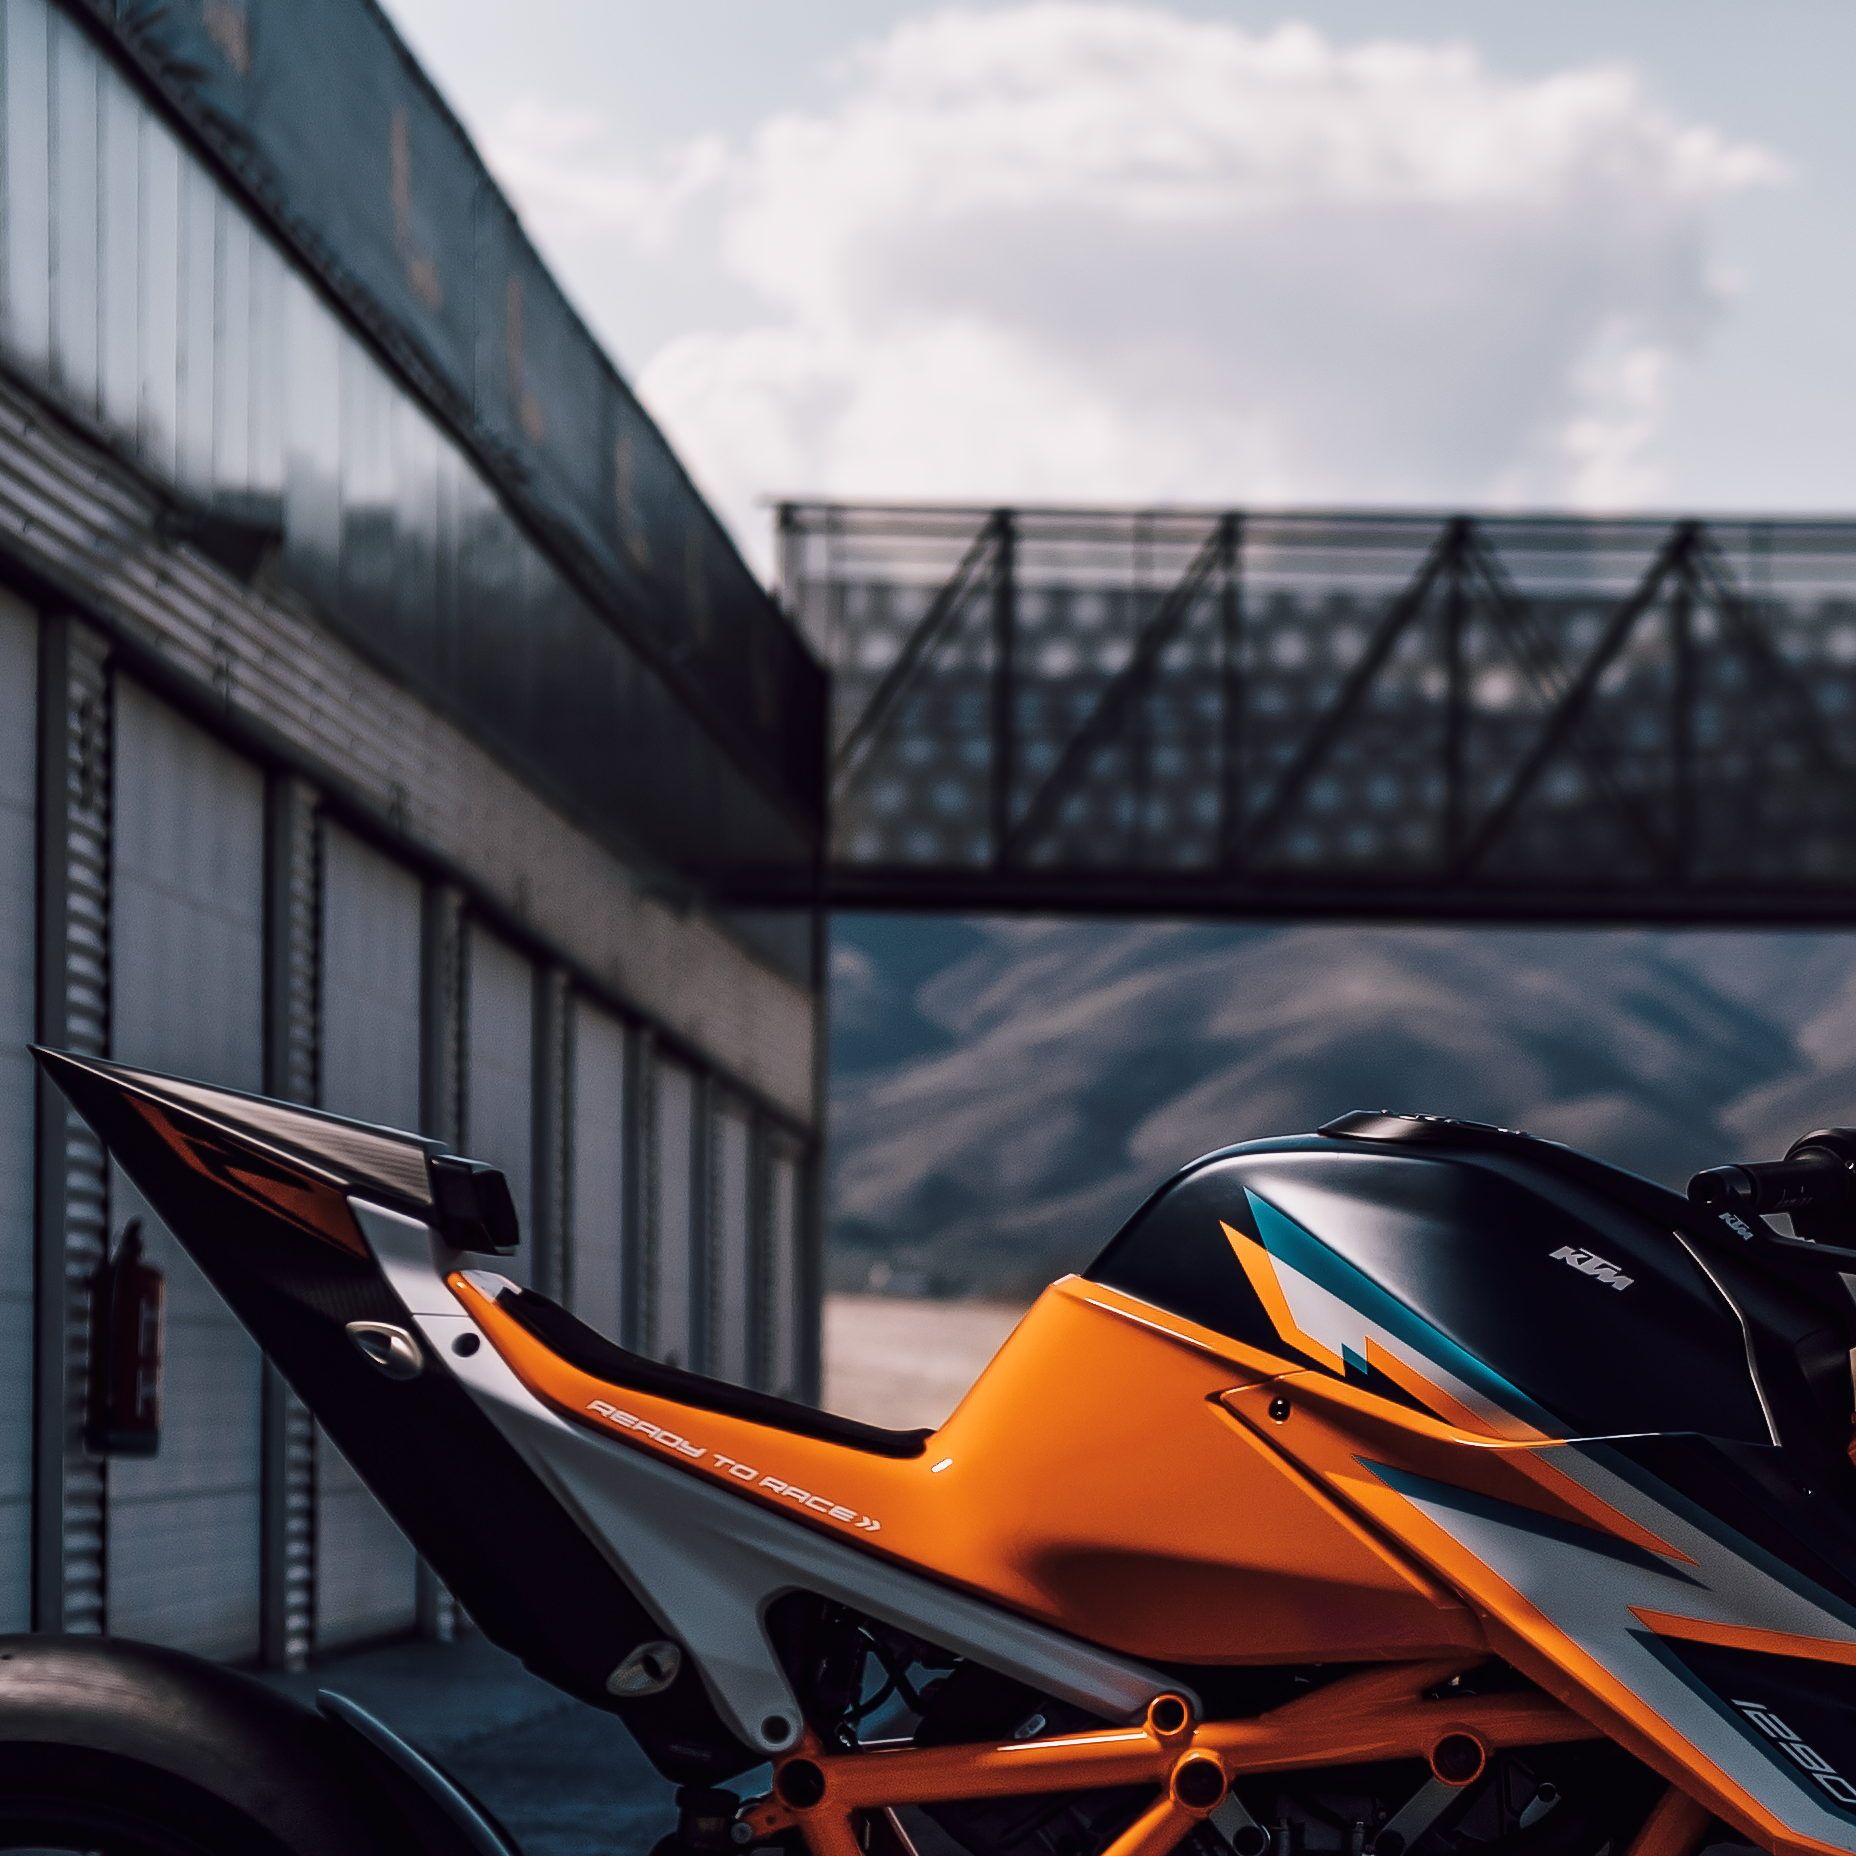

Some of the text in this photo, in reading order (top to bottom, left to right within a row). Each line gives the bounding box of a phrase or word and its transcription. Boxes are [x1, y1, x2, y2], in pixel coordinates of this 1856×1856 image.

[1718, 1212, 1755, 1242] KTM
[1548, 1245, 1635, 1291] KTM
[586, 1399, 859, 1523] READY TO RACE
